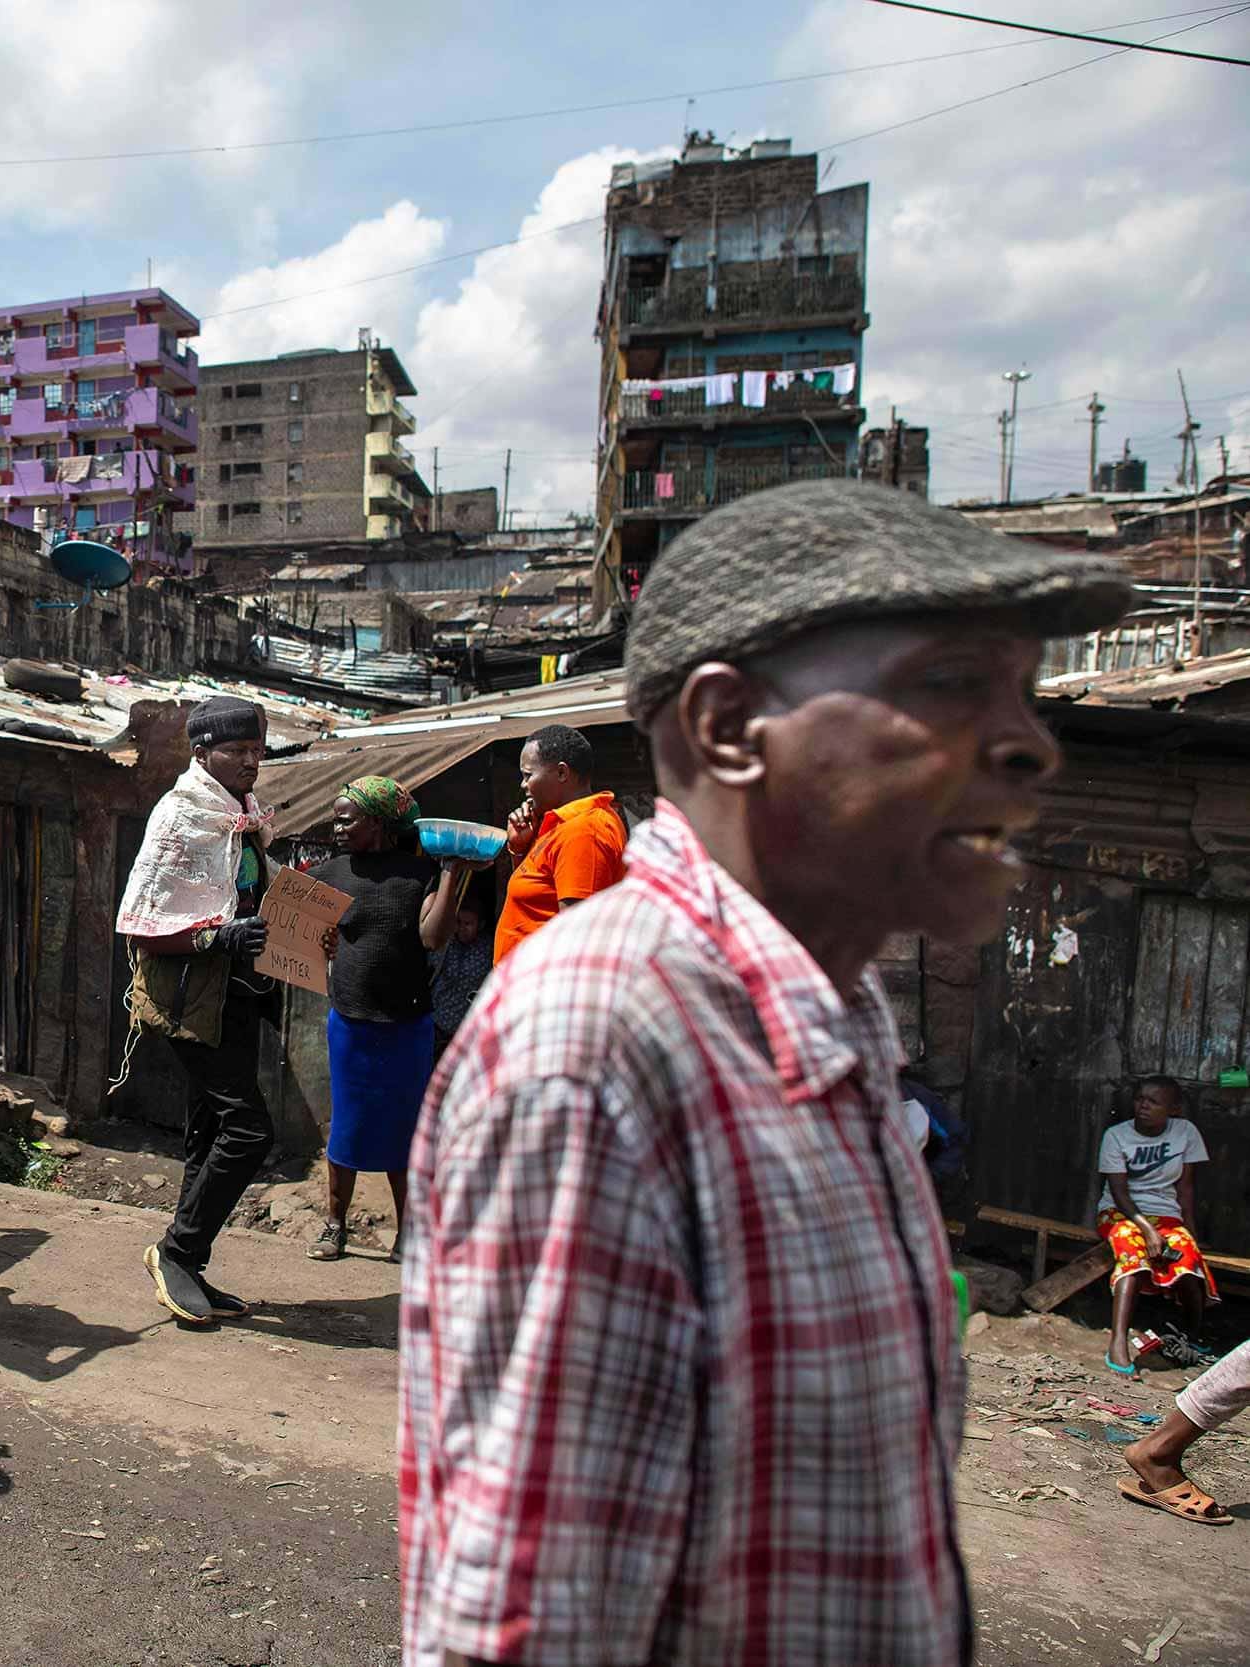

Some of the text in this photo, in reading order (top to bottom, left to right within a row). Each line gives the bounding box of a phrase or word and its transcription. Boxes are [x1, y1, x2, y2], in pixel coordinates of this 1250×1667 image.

[267, 901, 323, 943] OUR LIV
[270, 949, 311, 980] MATTER
[1132, 1142, 1171, 1165] NIKE
